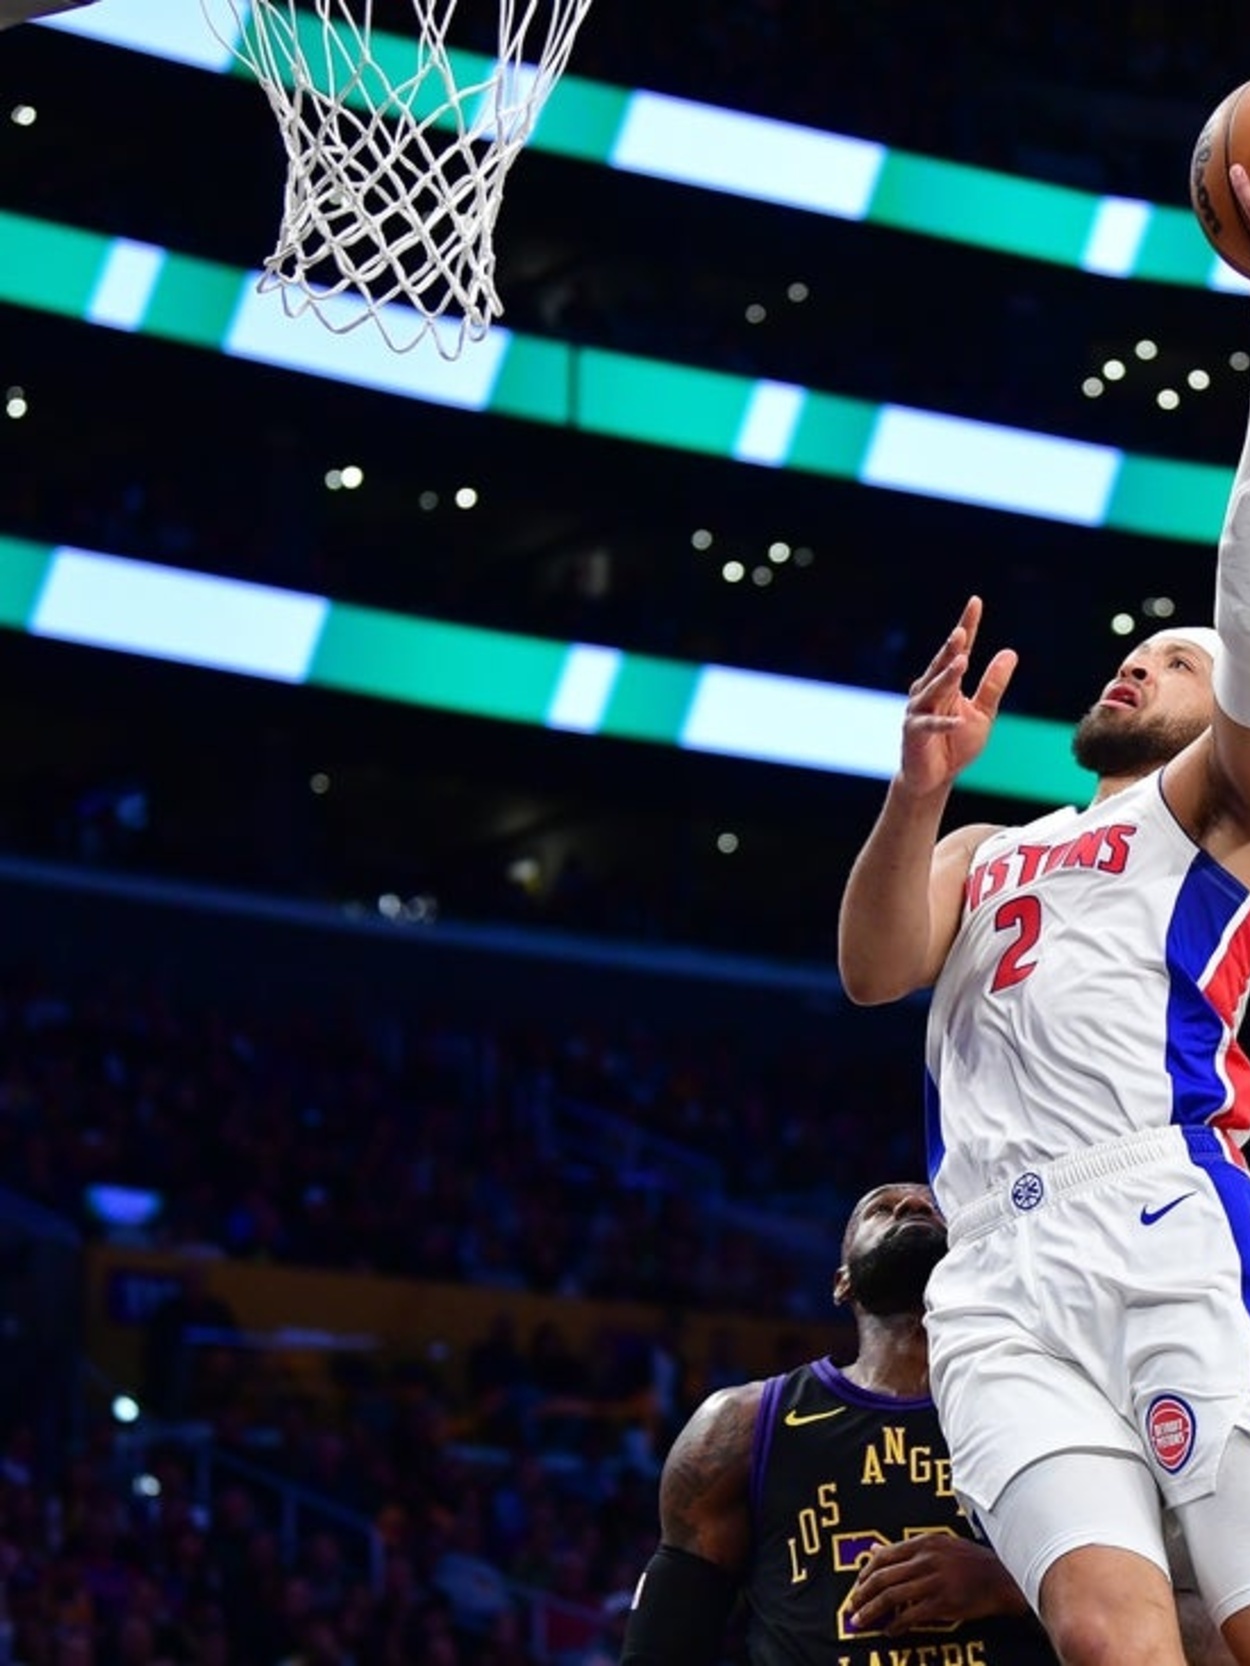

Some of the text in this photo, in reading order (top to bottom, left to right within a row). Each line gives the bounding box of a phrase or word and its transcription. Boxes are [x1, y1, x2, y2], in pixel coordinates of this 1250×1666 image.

[990, 895, 1042, 994] 2
[788, 1427, 967, 1583] LOS ANGE
